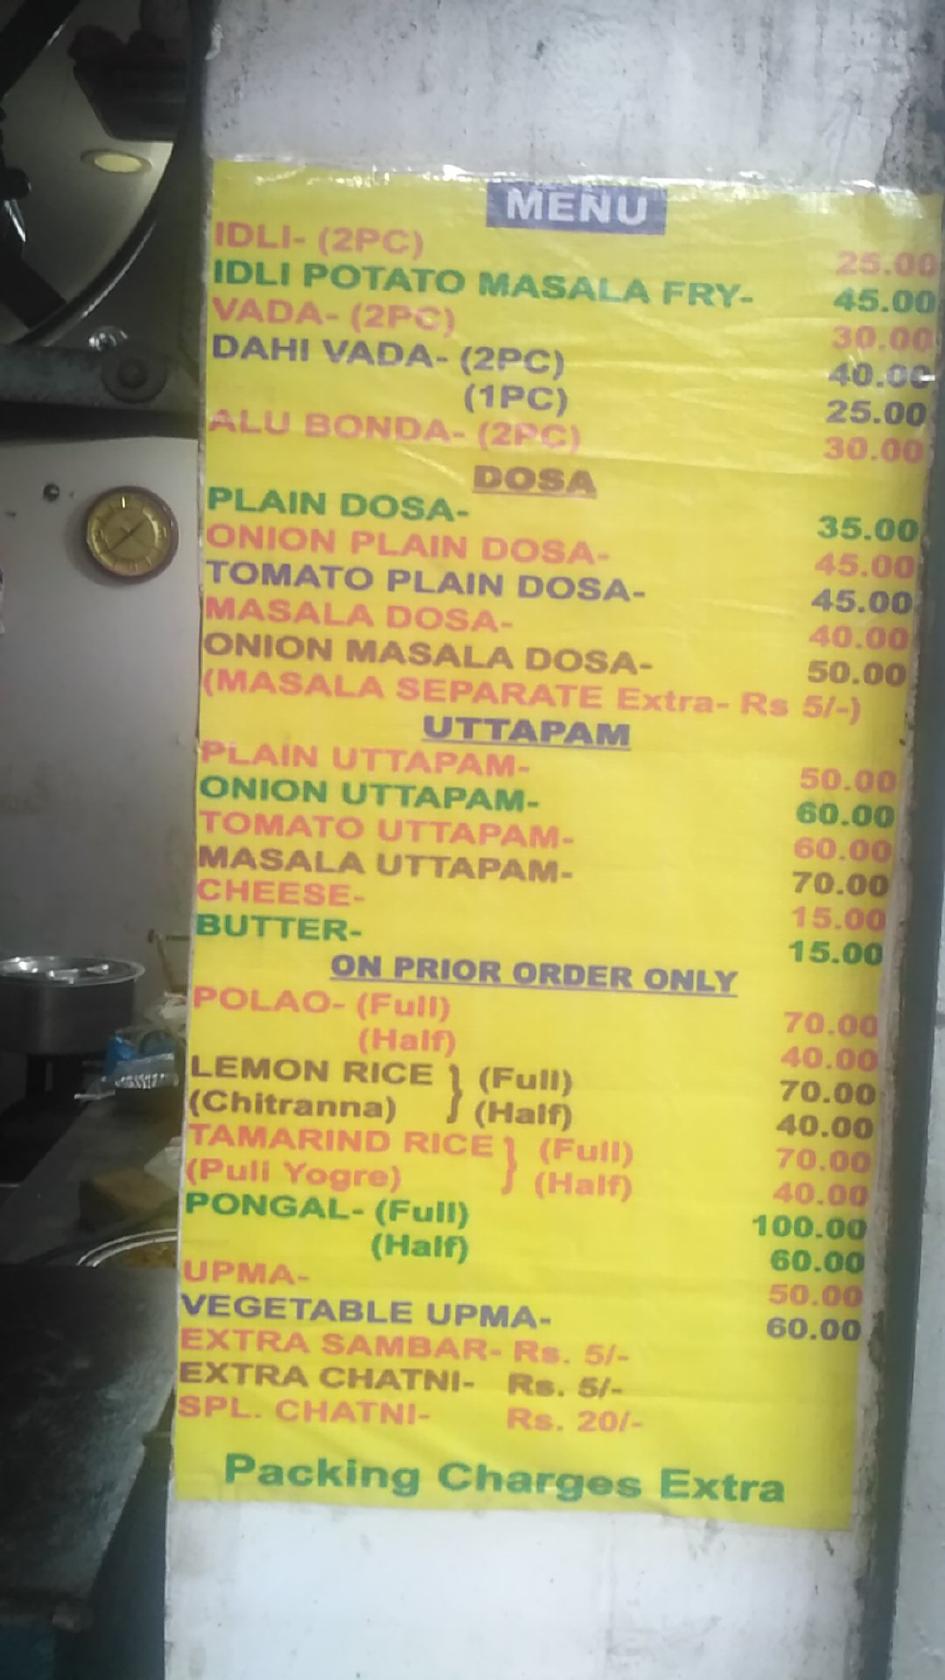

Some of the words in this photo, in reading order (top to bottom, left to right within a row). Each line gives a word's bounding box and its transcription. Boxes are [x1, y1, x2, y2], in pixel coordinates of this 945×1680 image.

[506, 188, 648, 225] MENU
[214, 221, 305, 249] IDLI-
[318, 226, 423, 260] (2PC)
[835, 251, 937, 278] 25.00
[213, 260, 290, 286] IDLI
[303, 262, 465, 296] POTATO
[478, 271, 650, 304] MASALA
[662, 281, 753, 308] FRY-
[833, 288, 937, 314] 45.00
[211, 297, 339, 326] VADA-
[351, 302, 455, 338] (2PC)
[831, 325, 934, 352] 30.00
[212, 334, 309, 362] DAHI
[322, 339, 448, 369] VADA-
[460, 346, 565, 380] (2PC)
[828, 362, 932, 389] 40.00
[464, 384, 568, 416] (1PC)
[825, 399, 928, 427] 25.00
[208, 409, 290, 435] ALU
[304, 412, 465, 443] BONDA-
[477, 421, 581, 452] (2PC)
[823, 436, 925, 464] 30.00
[473, 465, 597, 495] DOSA
[207, 486, 326, 516] PLAIN
[340, 493, 469, 522] DOSA-
[817, 515, 919, 543] 35.00
[206, 523, 335, 554] ONION
[351, 530, 468, 560] PLAIN
[481, 537, 610, 565] DOSA-
[814, 553, 915, 579] 45.00
[205, 560, 374, 591] TOMATO
[387, 569, 504, 597] PLAIN
[518, 575, 646, 602] DOSA-
[811, 589, 913, 615] 45.00
[204, 597, 374, 627] MASALA
[386, 605, 513, 633] DOSA-
[808, 625, 910, 651] 40.00
[203, 633, 333, 662] ONION
[346, 639, 514, 670] MASALA
[525, 648, 653, 676] DOSA-
[807, 660, 907, 687] 50.00
[203, 668, 384, 699] (MASALA
[396, 677, 602, 709] SEPARATE
[617, 687, 730, 714] Extra-
[740, 692, 789, 717] Rs
[802, 695, 862, 725] 5/-)
[423, 715, 631, 746] UTTAPAM
[200, 740, 318, 768] PLAIN
[332, 746, 530, 777] UTTAPAM-
[800, 767, 898, 793] 50.00
[200, 775, 327, 803] ONION
[342, 783, 539, 813] UTTAPAM-
[796, 801, 895, 828] 60.00
[199, 810, 365, 840] TOMATO
[377, 818, 574, 849] UTTAPAM-
[793, 837, 893, 863] 60.00
[198, 845, 366, 875] MASALA
[376, 853, 573, 883] UTTAPAM-
[792, 871, 890, 897] 70.00
[197, 878, 365, 907] CHEESE-
[791, 906, 887, 931] 15.00
[195, 913, 362, 942] BUTTER-
[788, 940, 883, 966] 15.00
[331, 954, 381, 979] ON
[394, 957, 502, 983] PRIOR
[513, 962, 633, 988] ORDER
[644, 968, 739, 993] ONLY
[193, 985, 345, 1013] POLAO-
[356, 991, 450, 1022] (Full)
[784, 1011, 879, 1038] 70.00
[359, 1028, 456, 1057] (Half)
[780, 1046, 879, 1072] 40.00
[191, 1055, 329, 1083] LEMON
[343, 1061, 434, 1086] RICE
[479, 1066, 573, 1096] (Full)
[780, 1080, 876, 1106] 70.00
[188, 1089, 397, 1124] (Chitranna)
[475, 1101, 573, 1131] (Half)
[776, 1114, 874, 1140] 40.00
[188, 1123, 391, 1153] TAMARIND
[404, 1131, 494, 1158] RICE
[538, 1138, 634, 1168] (Full)
[775, 1148, 872, 1173] 70.00
[284, 1162, 401, 1193] Yogre)
[534, 1172, 632, 1203] (Half)
[773, 1182, 869, 1207] 40.00
[185, 1192, 364, 1220] PONGAL-
[375, 1199, 469, 1229] (Full)
[752, 1214, 867, 1240] 100.00
[371, 1233, 469, 1265] (Half)
[770, 1249, 865, 1274] 60.00
[183, 1259, 310, 1285] UPMA-
[768, 1283, 864, 1308] 50.00
[180, 1294, 413, 1324] VEGETABLE
[427, 1302, 552, 1329] UPMA-
[766, 1317, 862, 1342] 60.00
[180, 1327, 310, 1354] EXTRA
[321, 1333, 501, 1361] SAMBAR-
[514, 1340, 570, 1365] Rs.
[584, 1344, 629, 1367] 5/-
[179, 1362, 309, 1387] EXTRA
[319, 1367, 474, 1392] CHATNI-
[508, 1373, 565, 1397] Rs.
[578, 1377, 623, 1399] 5/-
[177, 1395, 262, 1419] SPL.
[275, 1399, 430, 1425] CHATNI-
[507, 1408, 564, 1432] Rs.
[577, 1410, 643, 1433] 20/-
[225, 1453, 420, 1497] Packing
[438, 1462, 642, 1502] Charges
[660, 1468, 785, 1503] Extra
